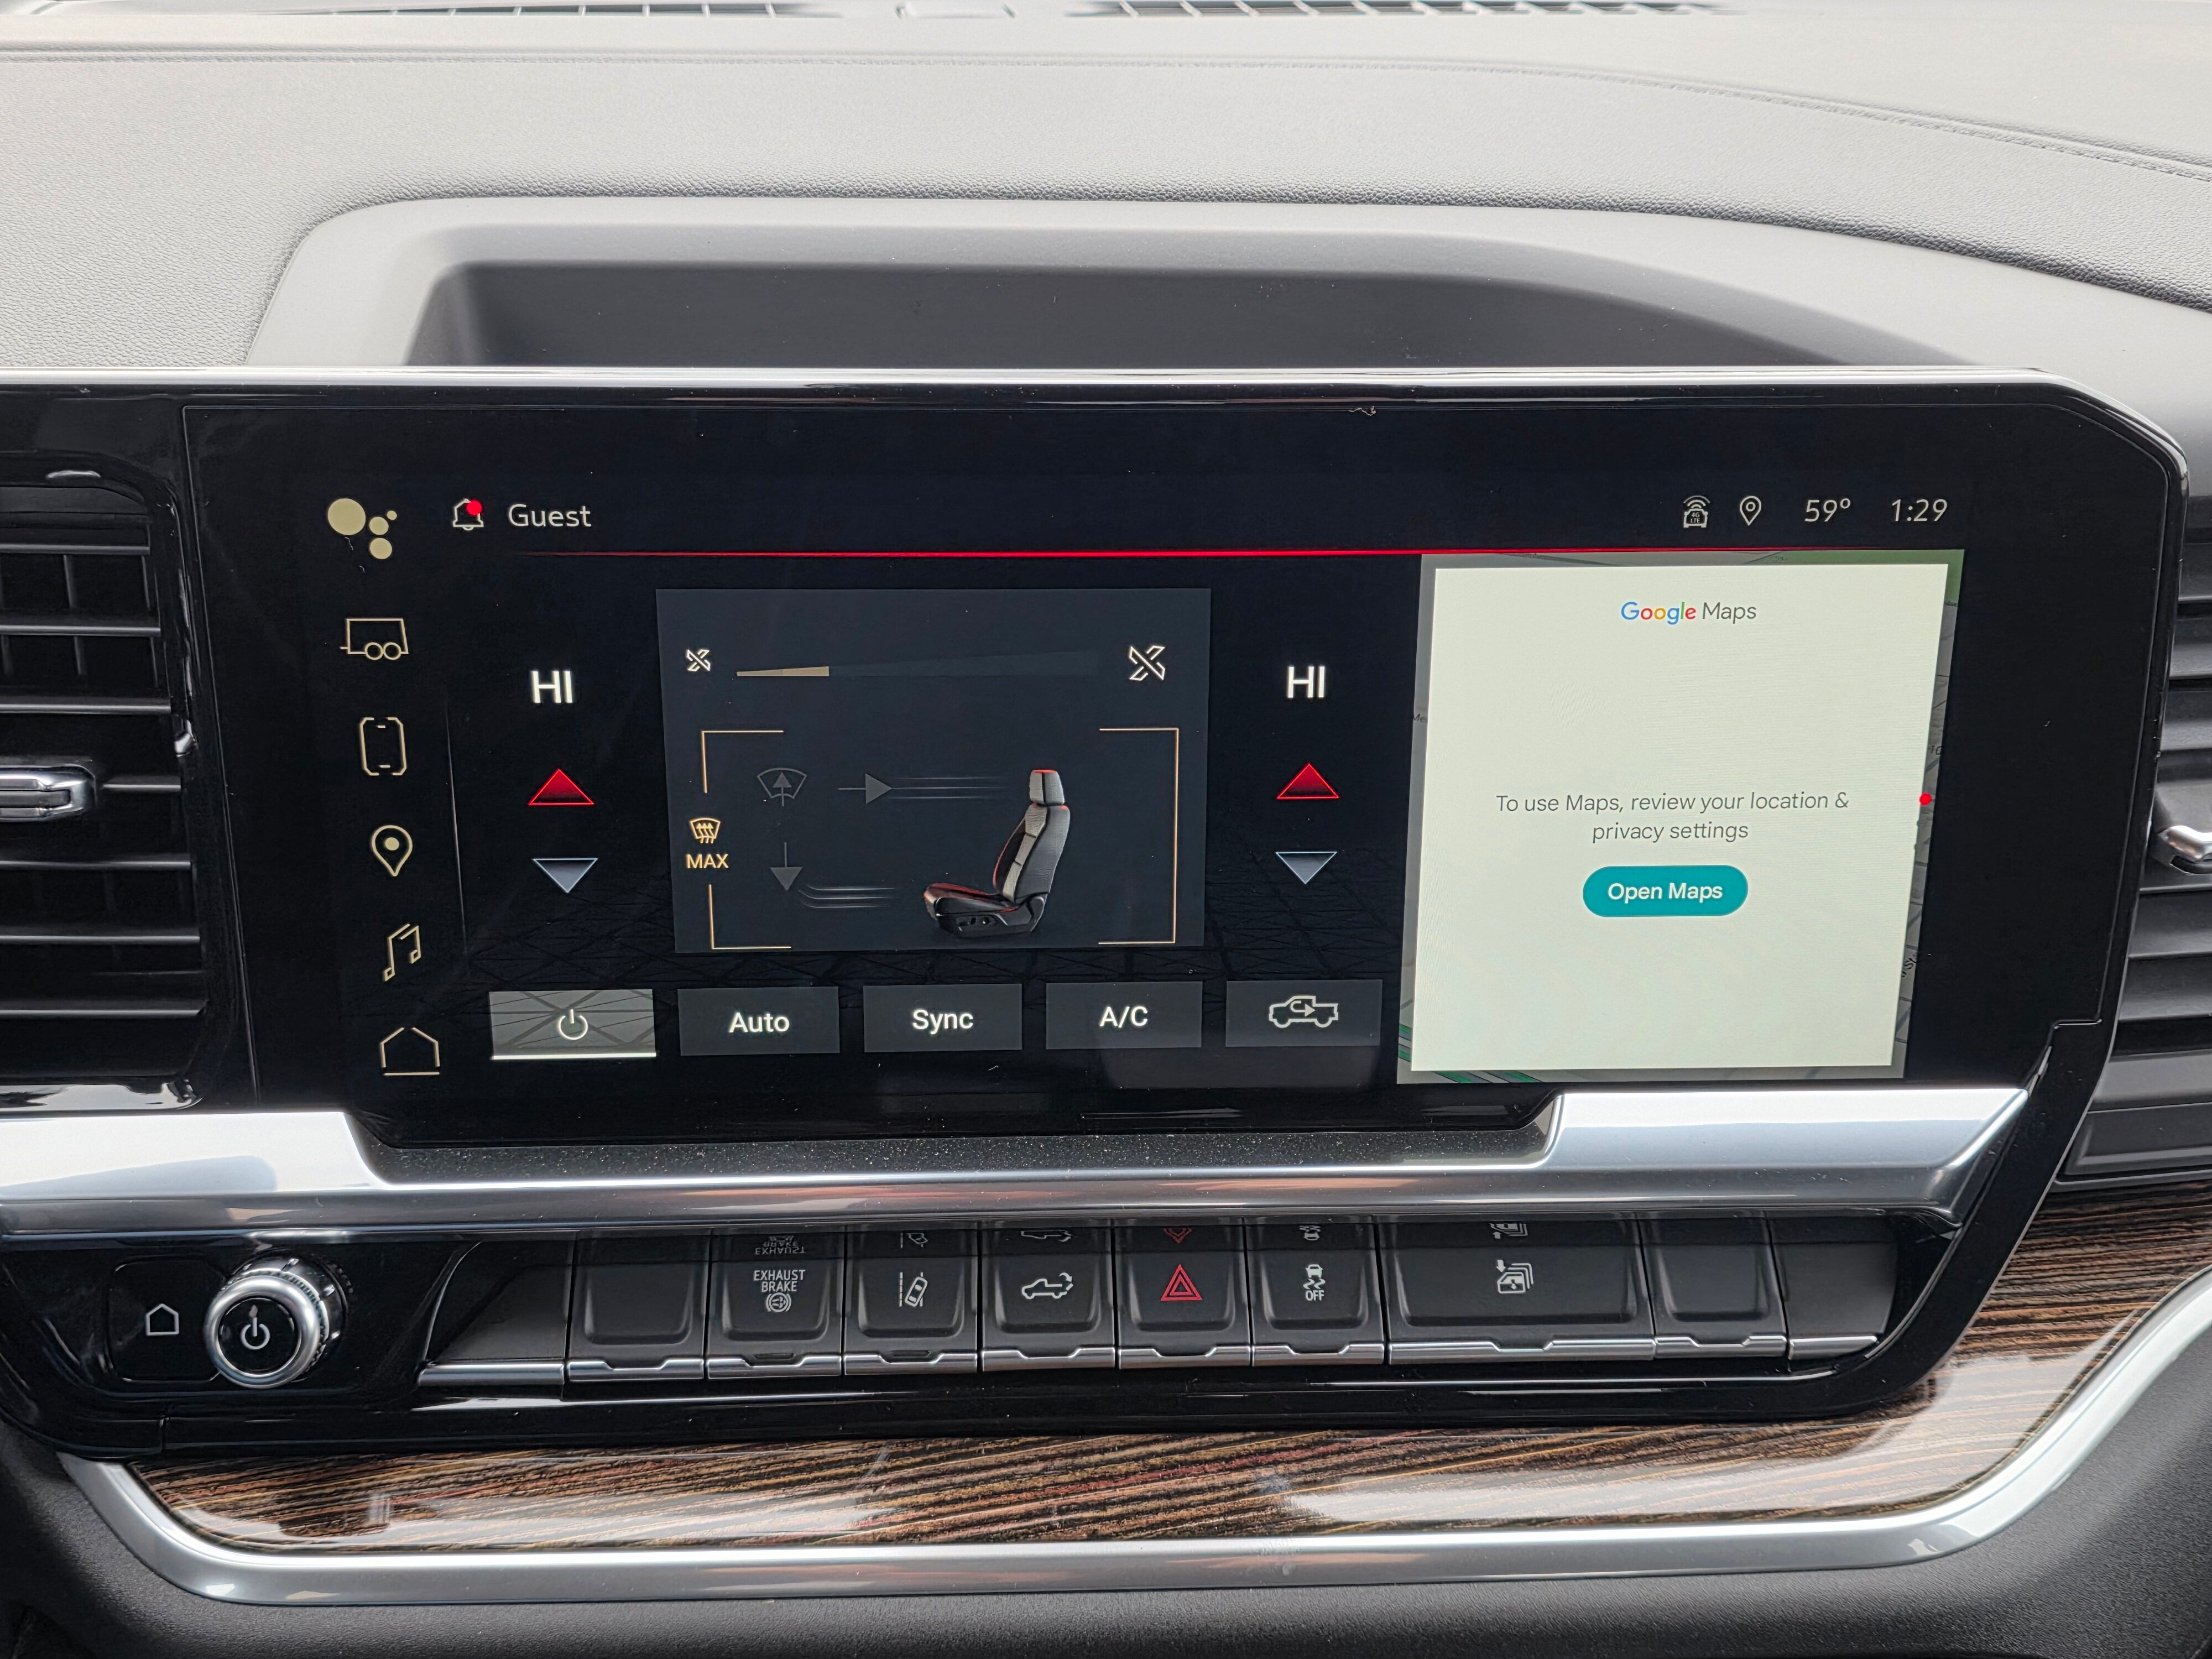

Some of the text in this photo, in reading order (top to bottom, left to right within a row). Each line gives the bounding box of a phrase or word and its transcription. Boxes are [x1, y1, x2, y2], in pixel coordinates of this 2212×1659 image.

[508, 503, 592, 528] Guest
[1891, 499, 1948, 521] 1:29
[1621, 601, 1757, 625] Google Maps
[531, 670, 573, 703] HI
[1287, 665, 1327, 698] HI
[1496, 791, 1849, 815] To use Maps, review your location &
[1593, 822, 1749, 844] privacy settings
[686, 853, 729, 869] MAX
[1608, 882, 1723, 904] Open Maps
[728, 1011, 791, 1033] Auto
[912, 1008, 974, 1036] Sync
[1099, 1005, 1149, 1029] A/C
[753, 1270, 806, 1281] EXHAUST
[761, 1280, 797, 1292] BRAKE
[1305, 1290, 1324, 1301] OFF
